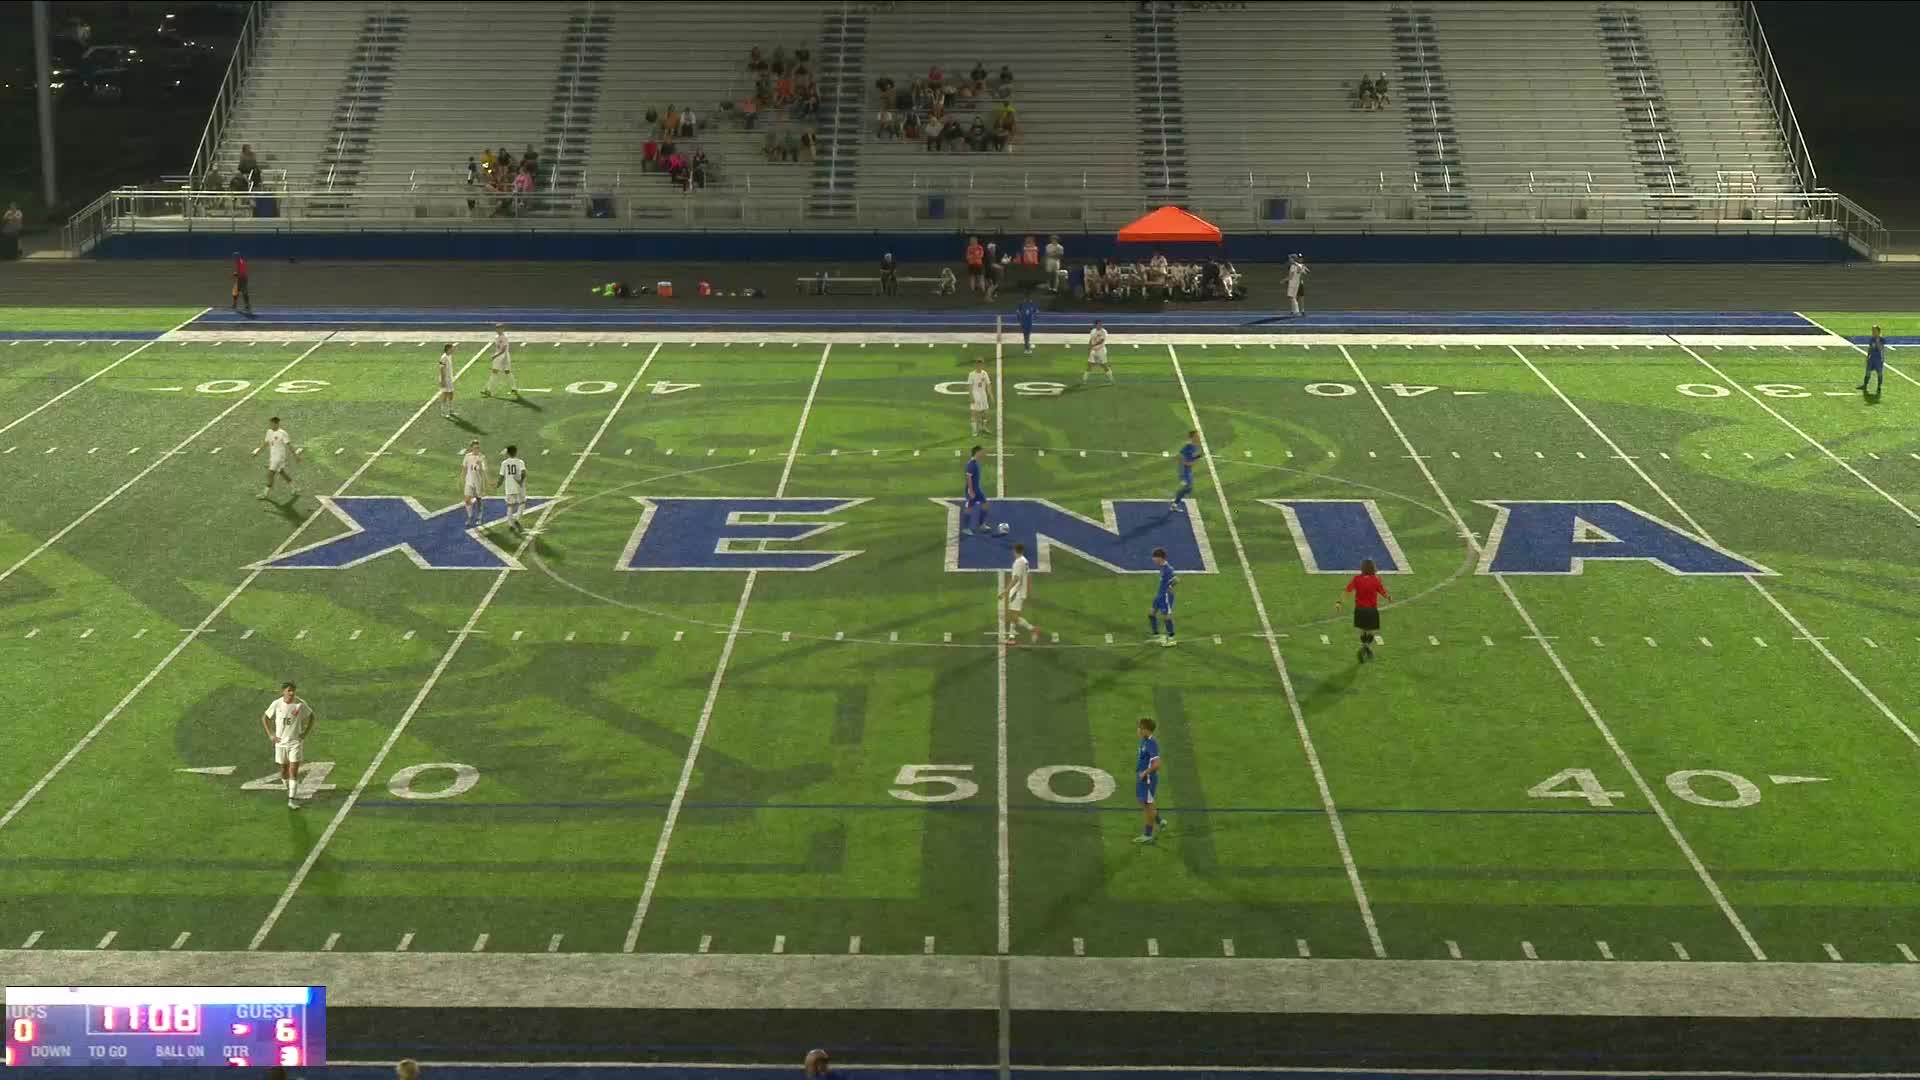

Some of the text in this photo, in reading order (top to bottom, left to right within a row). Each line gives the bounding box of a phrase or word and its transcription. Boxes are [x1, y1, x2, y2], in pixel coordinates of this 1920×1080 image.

[507, 464, 517, 475] 10
[239, 495, 1783, 577] XENIA
[283, 717, 291, 725] 16
[240, 762, 481, 799] 40
[887, 764, 1116, 803] 50
[1527, 768, 1761, 808] 40
